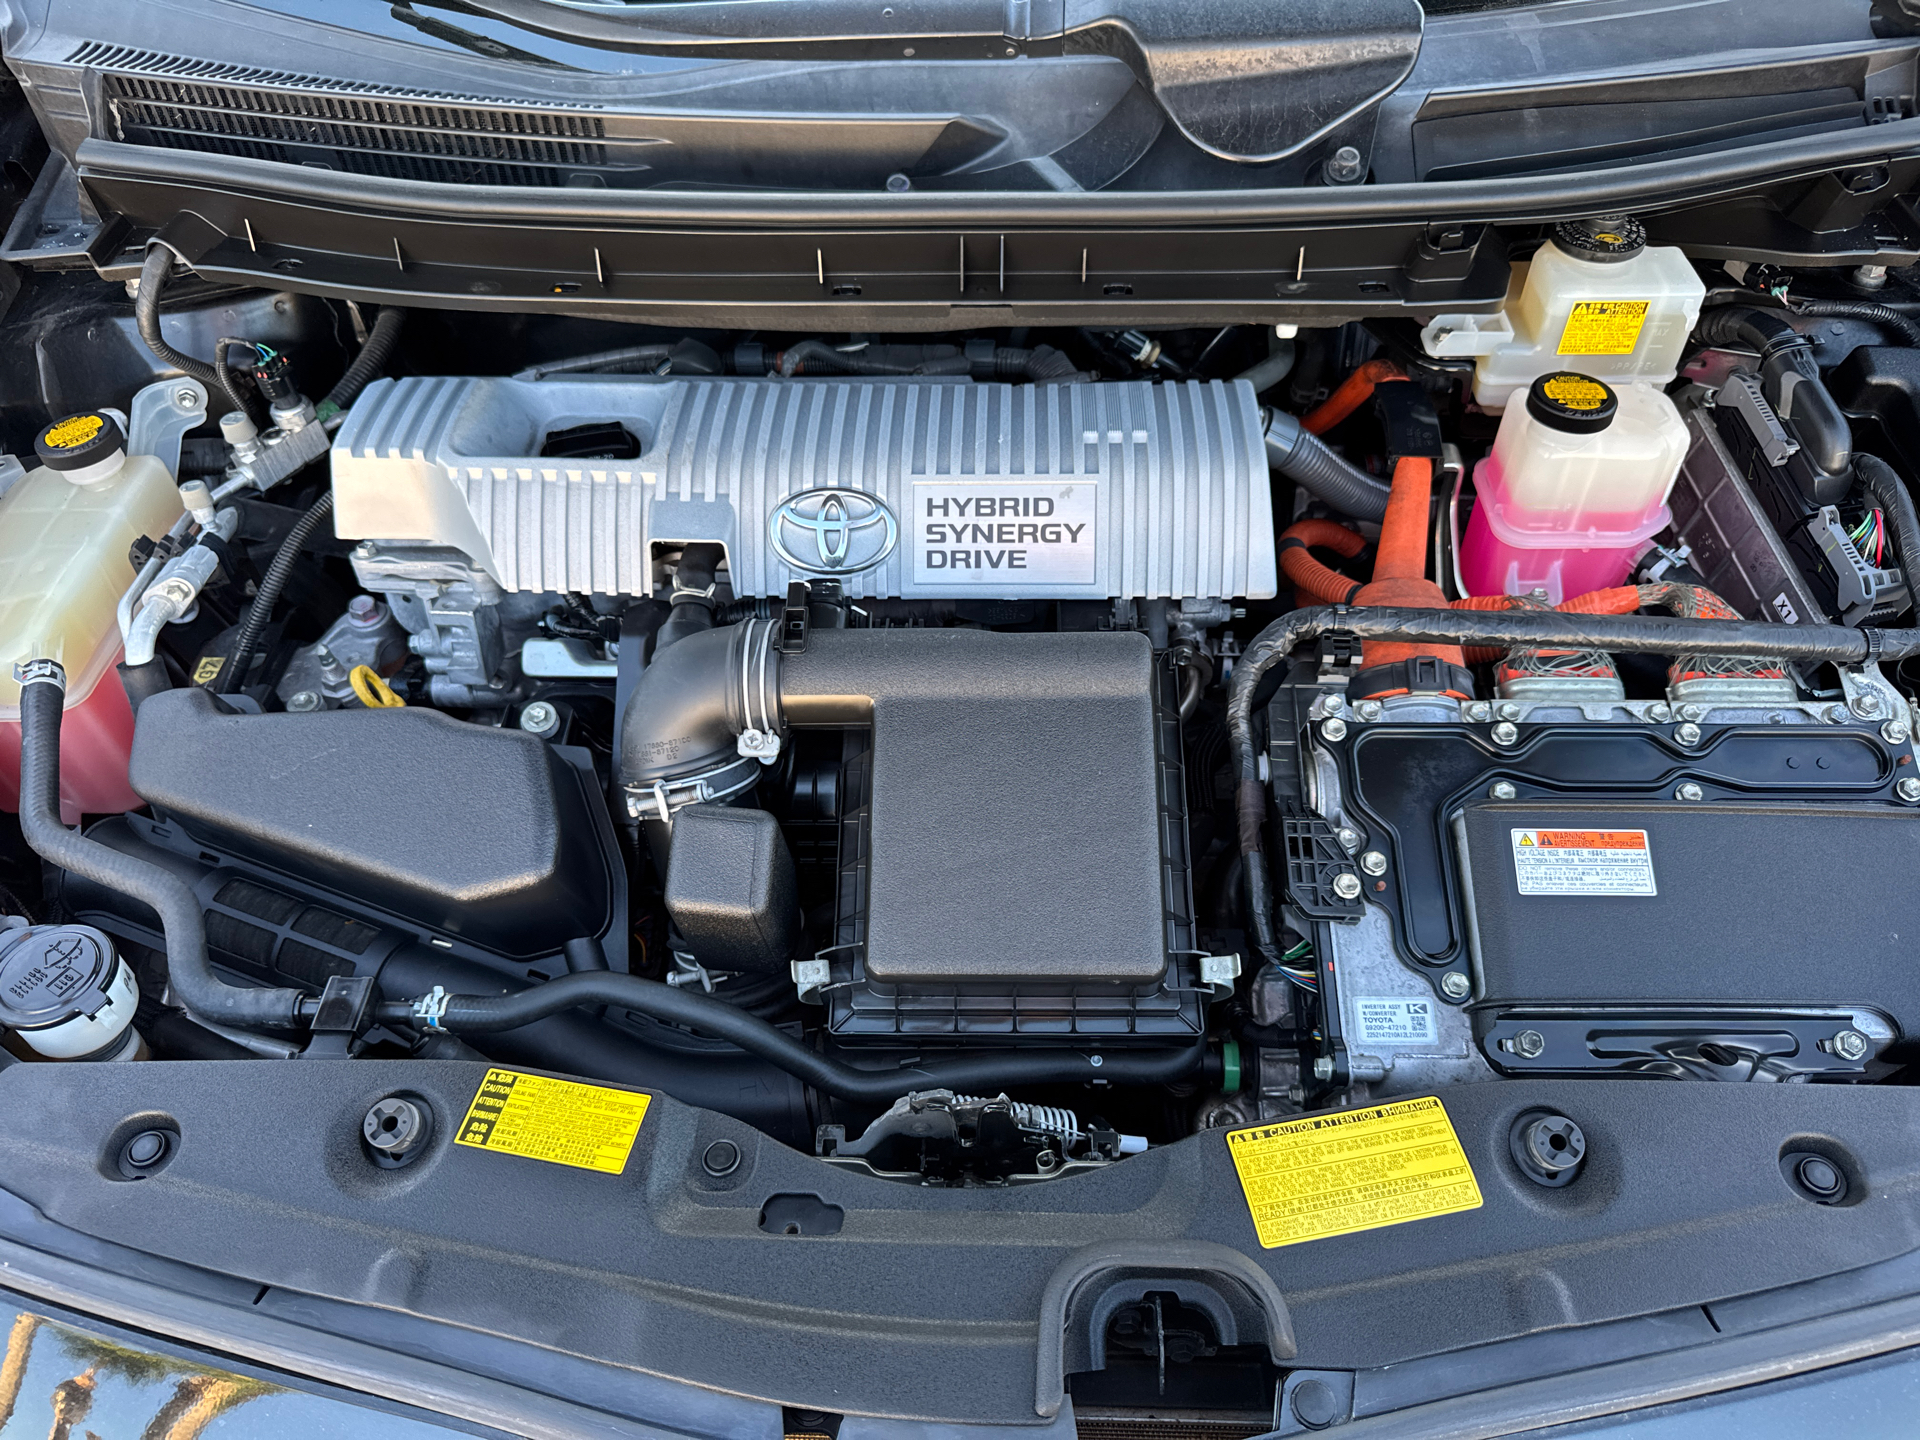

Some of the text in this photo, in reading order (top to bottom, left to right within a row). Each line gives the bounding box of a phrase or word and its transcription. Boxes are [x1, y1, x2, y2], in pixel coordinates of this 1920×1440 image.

[926, 497, 1055, 517] HYBRID
[926, 523, 1087, 544] SYNERGY
[926, 549, 1027, 569] DRIVE
[1776, 600, 1792, 619] X1
[199, 661, 218, 679] G7
[1553, 839, 1595, 847] AVERTISSEMENT
[483, 1082, 512, 1095] CAUTION
[477, 1096, 506, 1108] ATTENTION
[1380, 1100, 1436, 1116] ВНИМАНИЕ
[1269, 1111, 1377, 1136] CAUTION ATTENTION
[1243, 1130, 1264, 1141] 警告
[1257, 1208, 1286, 1220] READY
